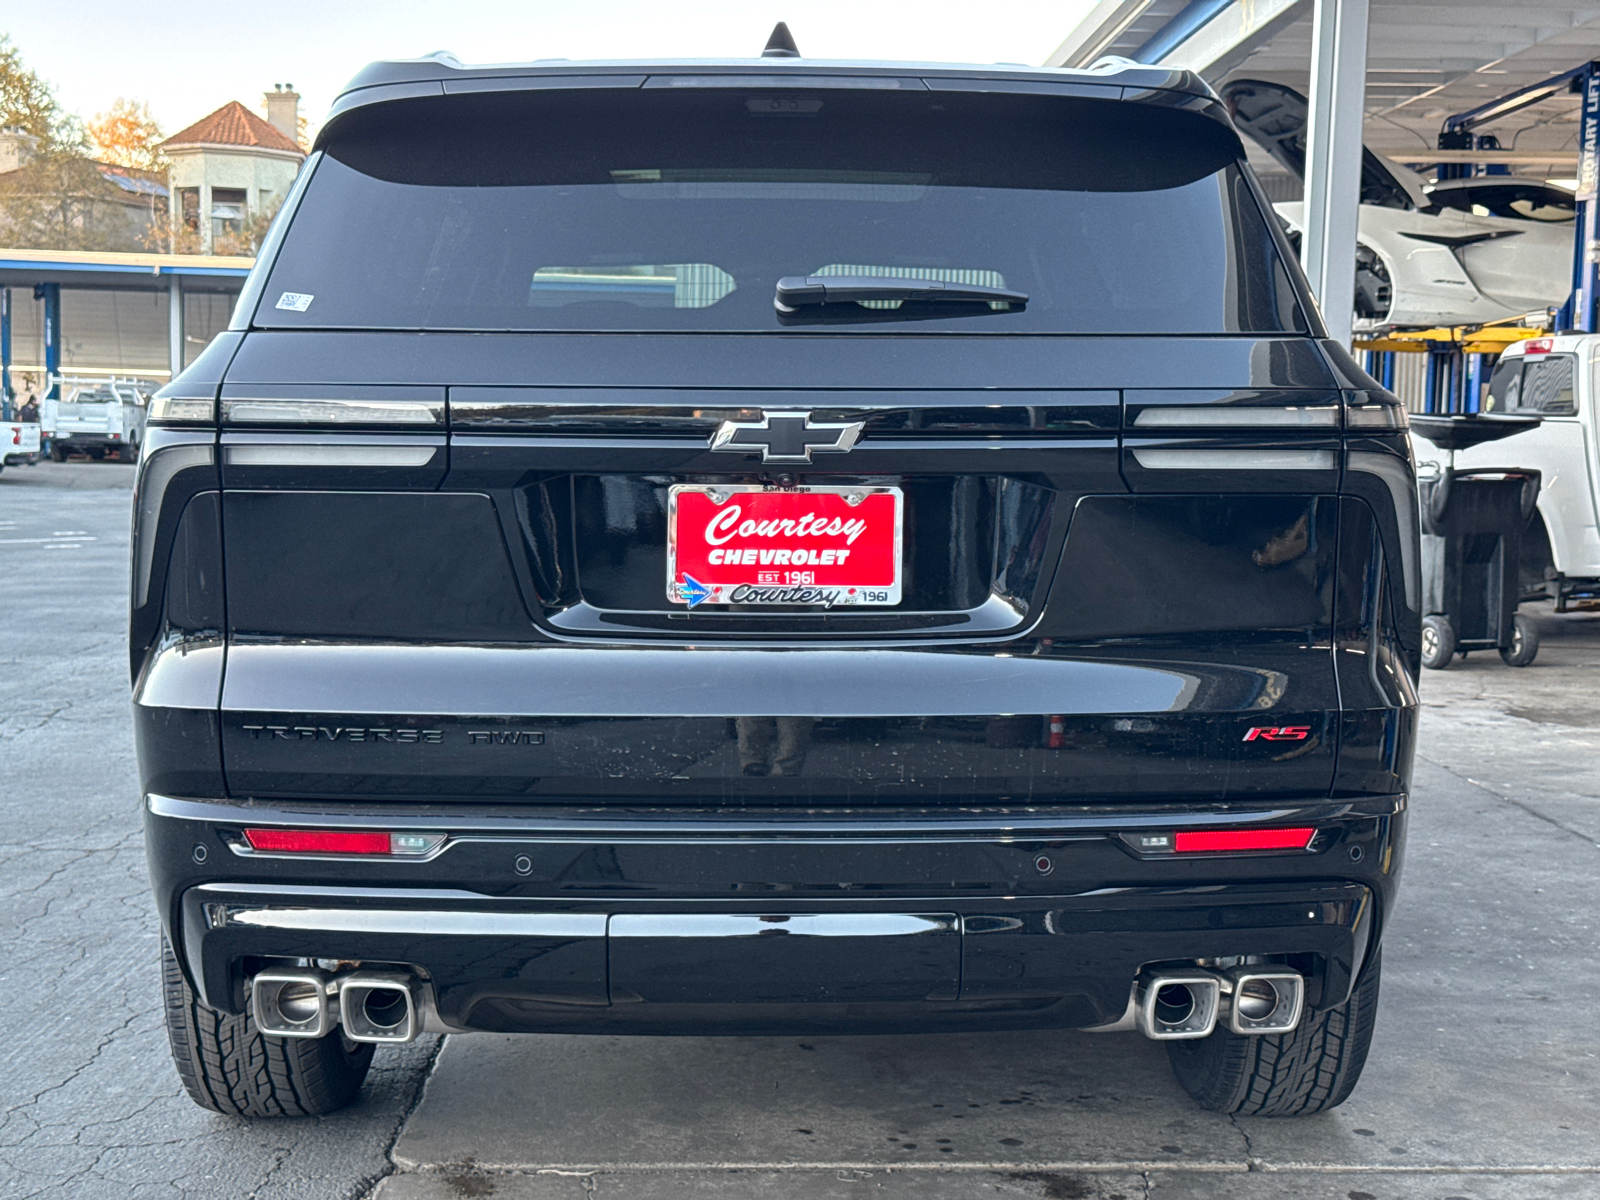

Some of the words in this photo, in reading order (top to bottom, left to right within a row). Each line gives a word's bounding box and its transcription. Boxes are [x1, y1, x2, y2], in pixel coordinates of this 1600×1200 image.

[1587, 78, 1600, 113] LIFT
[783, 486, 811, 494] Diego
[705, 505, 867, 546] Courtesy
[708, 549, 850, 566] CHEVROLET
[758, 573, 779, 583] EST
[784, 571, 815, 584] 1961
[729, 583, 841, 609] Courtesy
[862, 591, 888, 602] 1961
[243, 725, 444, 744] TRAVERSE
[468, 731, 546, 745] AWD
[1242, 725, 1311, 742] RS
